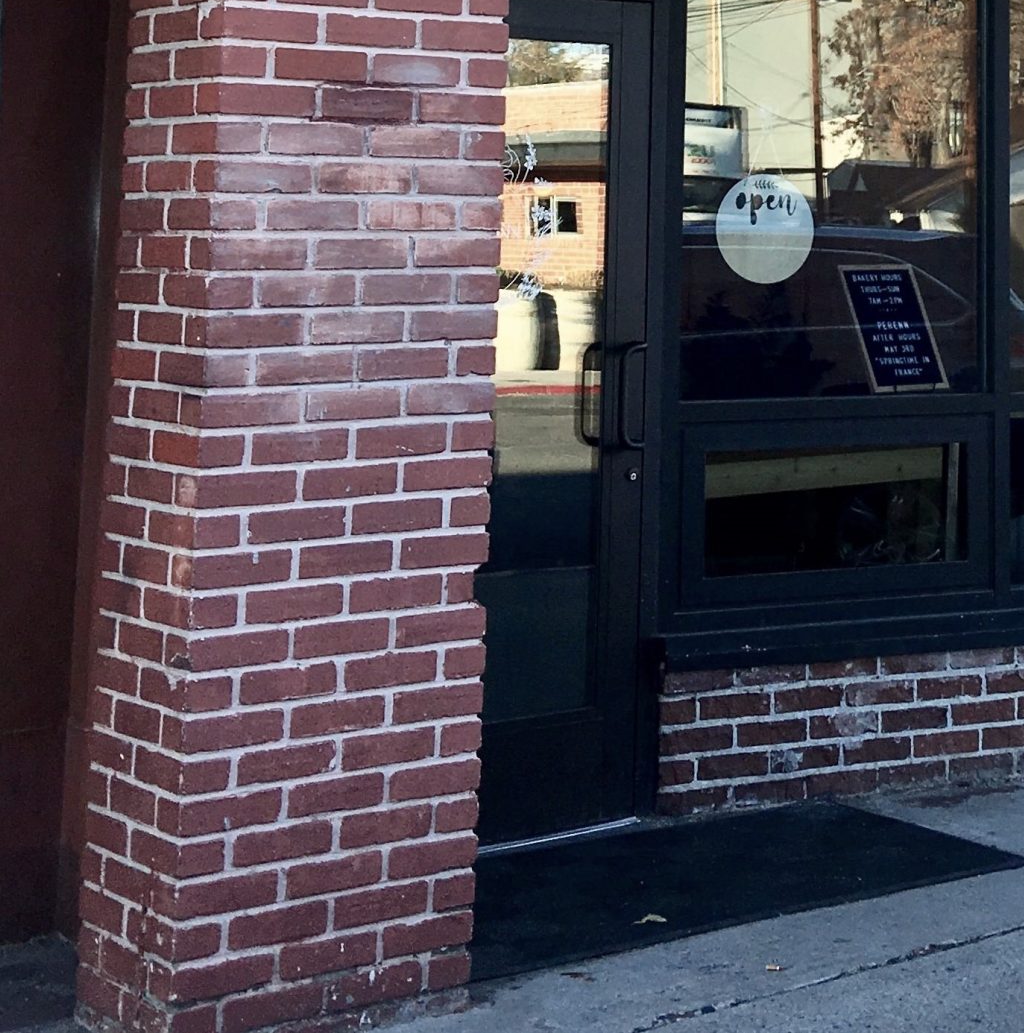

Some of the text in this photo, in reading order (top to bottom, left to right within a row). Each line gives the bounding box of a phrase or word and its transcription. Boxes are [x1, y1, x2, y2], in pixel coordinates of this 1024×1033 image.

[735, 192, 798, 225] open
[852, 273, 902, 282] BAKERY HOURS
[876, 321, 910, 330] PERENN
[872, 332, 921, 342] AFTER HOURS
[884, 345, 898, 353] MAY
[922, 355, 931, 364] IN
